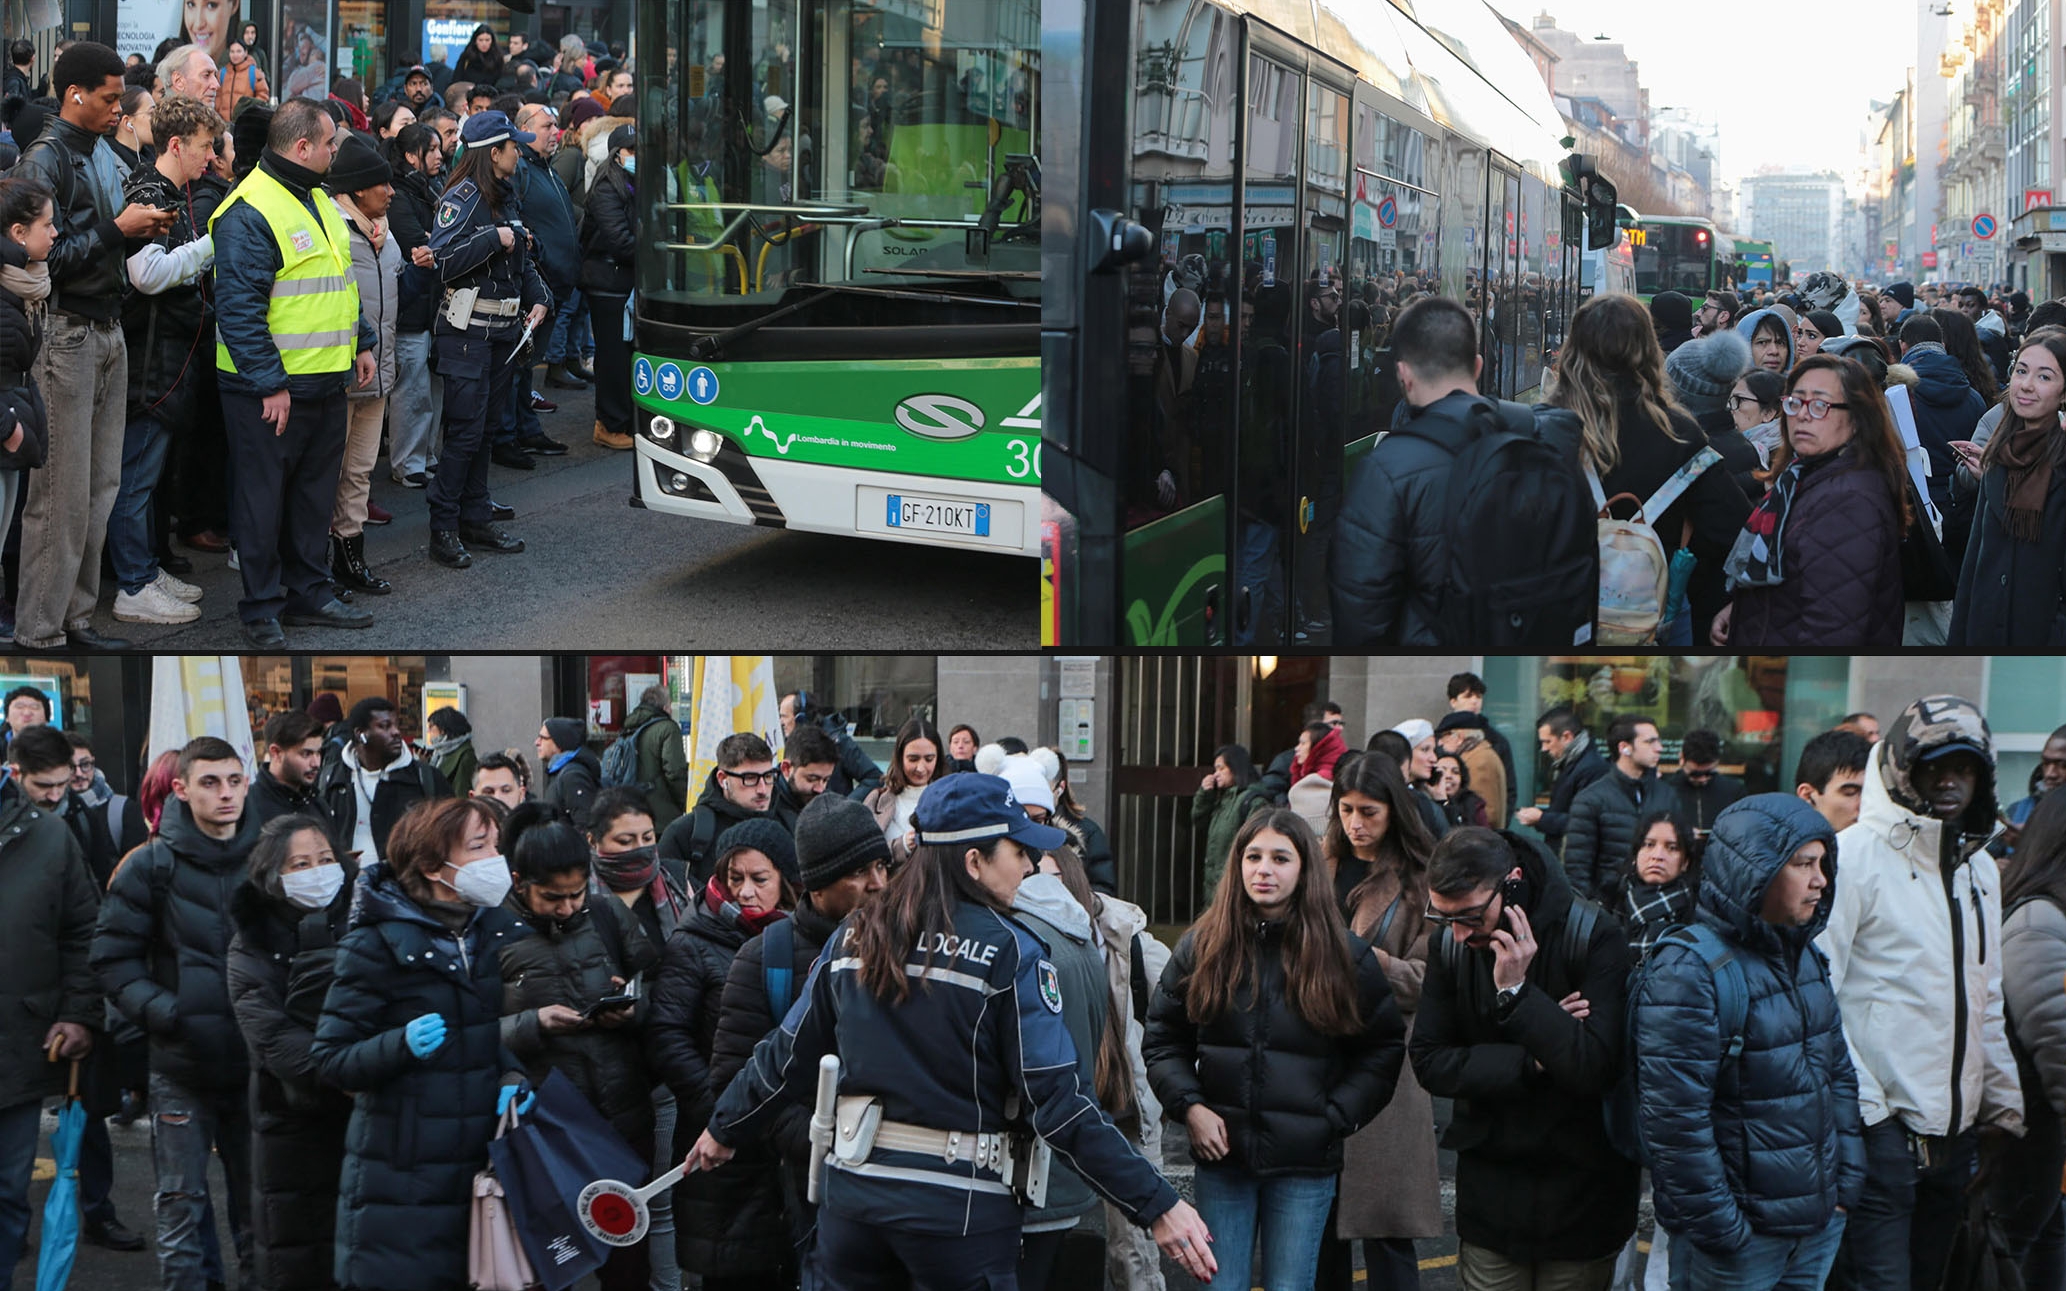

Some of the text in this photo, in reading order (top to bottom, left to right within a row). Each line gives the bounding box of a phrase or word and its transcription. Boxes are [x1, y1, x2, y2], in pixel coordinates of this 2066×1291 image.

[117, 32, 155, 40] ECNOLOGIA
[797, 434, 840, 446] Lombardia
[851, 442, 897, 452] movimento
